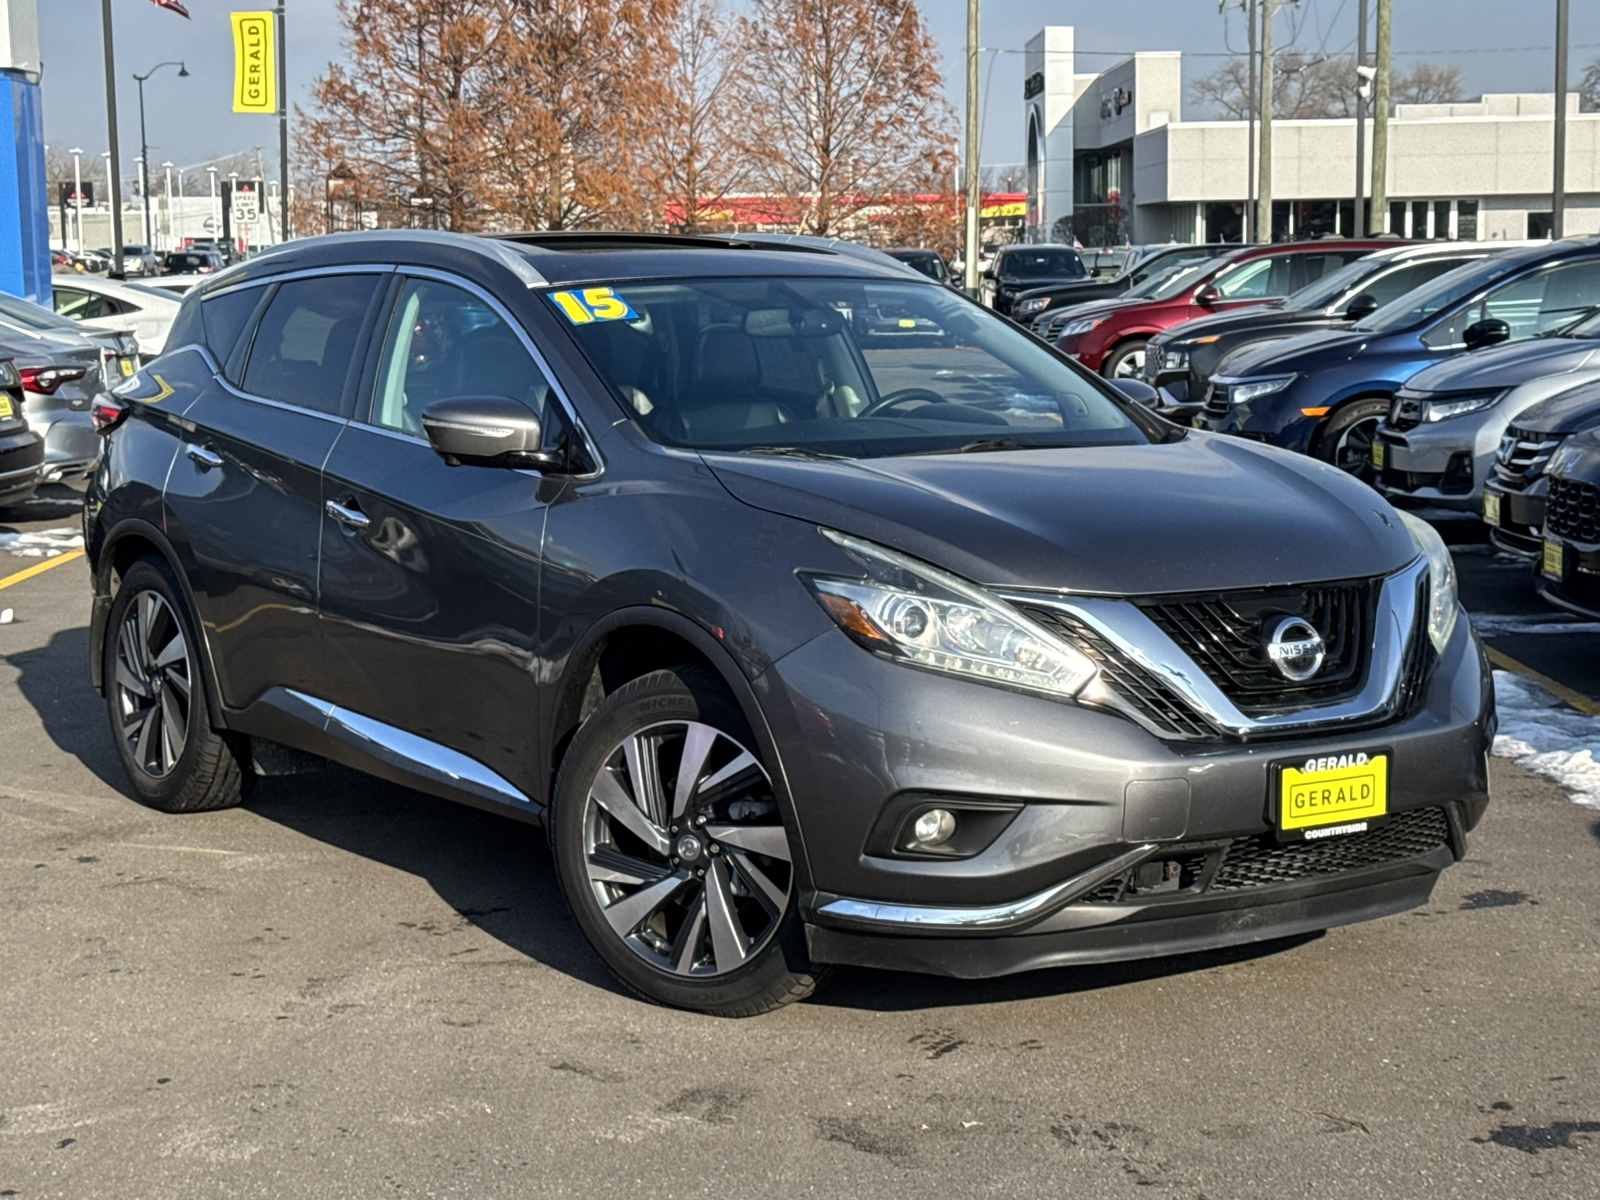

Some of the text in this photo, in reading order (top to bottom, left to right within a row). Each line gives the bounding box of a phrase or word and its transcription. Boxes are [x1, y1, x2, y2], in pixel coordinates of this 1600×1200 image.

[248, 25, 261, 99] GERALD
[235, 208, 257, 221] 35
[553, 287, 628, 323] 15
[1279, 643, 1323, 656] NISSAN
[1304, 752, 1368, 774] GERALD
[1294, 783, 1371, 809] GERALD
[1304, 822, 1368, 840] COUNTRYSIDE
